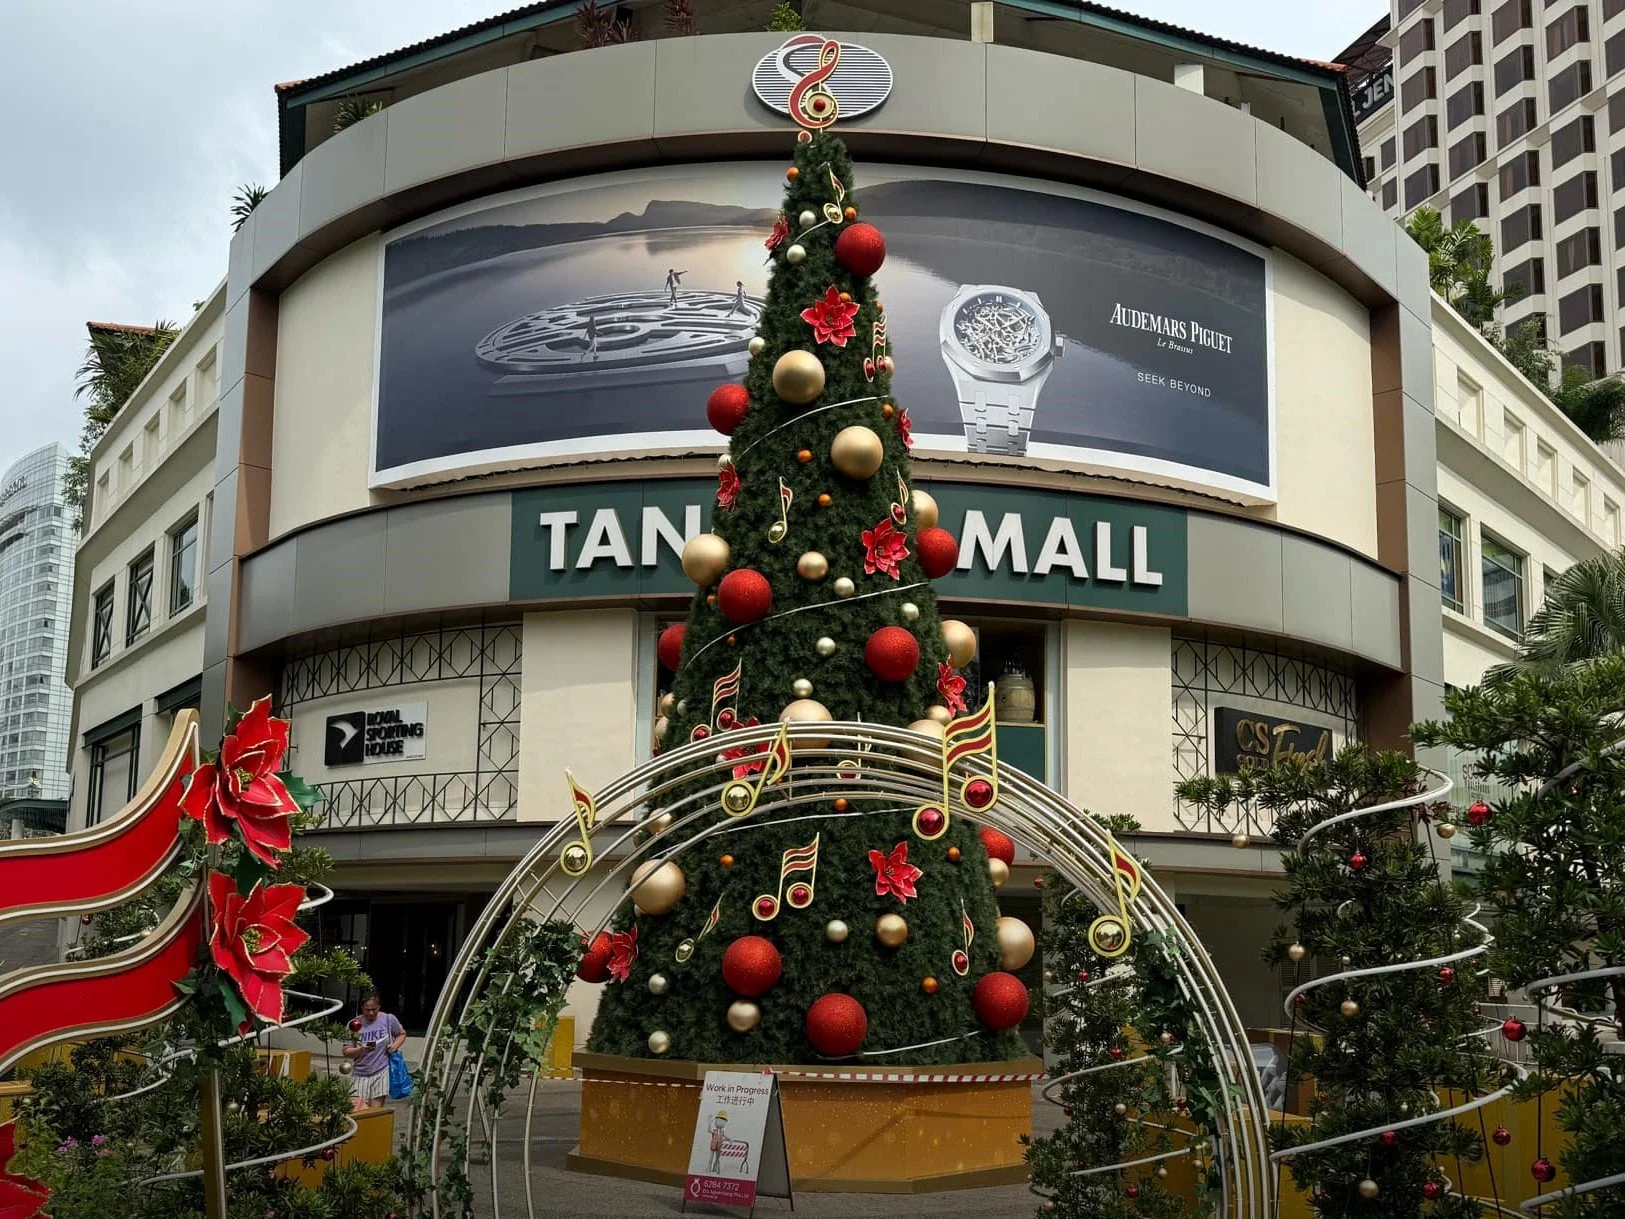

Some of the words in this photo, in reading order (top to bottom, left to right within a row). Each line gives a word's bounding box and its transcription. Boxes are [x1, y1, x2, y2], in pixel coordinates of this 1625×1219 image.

[1362, 73, 1394, 109] JEN
[1110, 302, 1187, 340] AUDEMARS
[1190, 320, 1232, 353] PIGUET
[1137, 372, 1166, 387] SEEK
[1170, 379, 1211, 397] BEYOND
[956, 509, 1163, 586] MALL
[366, 709, 403, 726] ROYAL
[365, 723, 424, 742] SPORTING
[1236, 719, 1270, 755] CS
[365, 740, 404, 757] HOUSE
[361, 1029, 386, 1042] NIKE
[706, 1082, 726, 1092] Work
[727, 1084, 735, 1093] in
[736, 1085, 769, 1096] Progress
[703, 1180, 721, 1189] 6284
